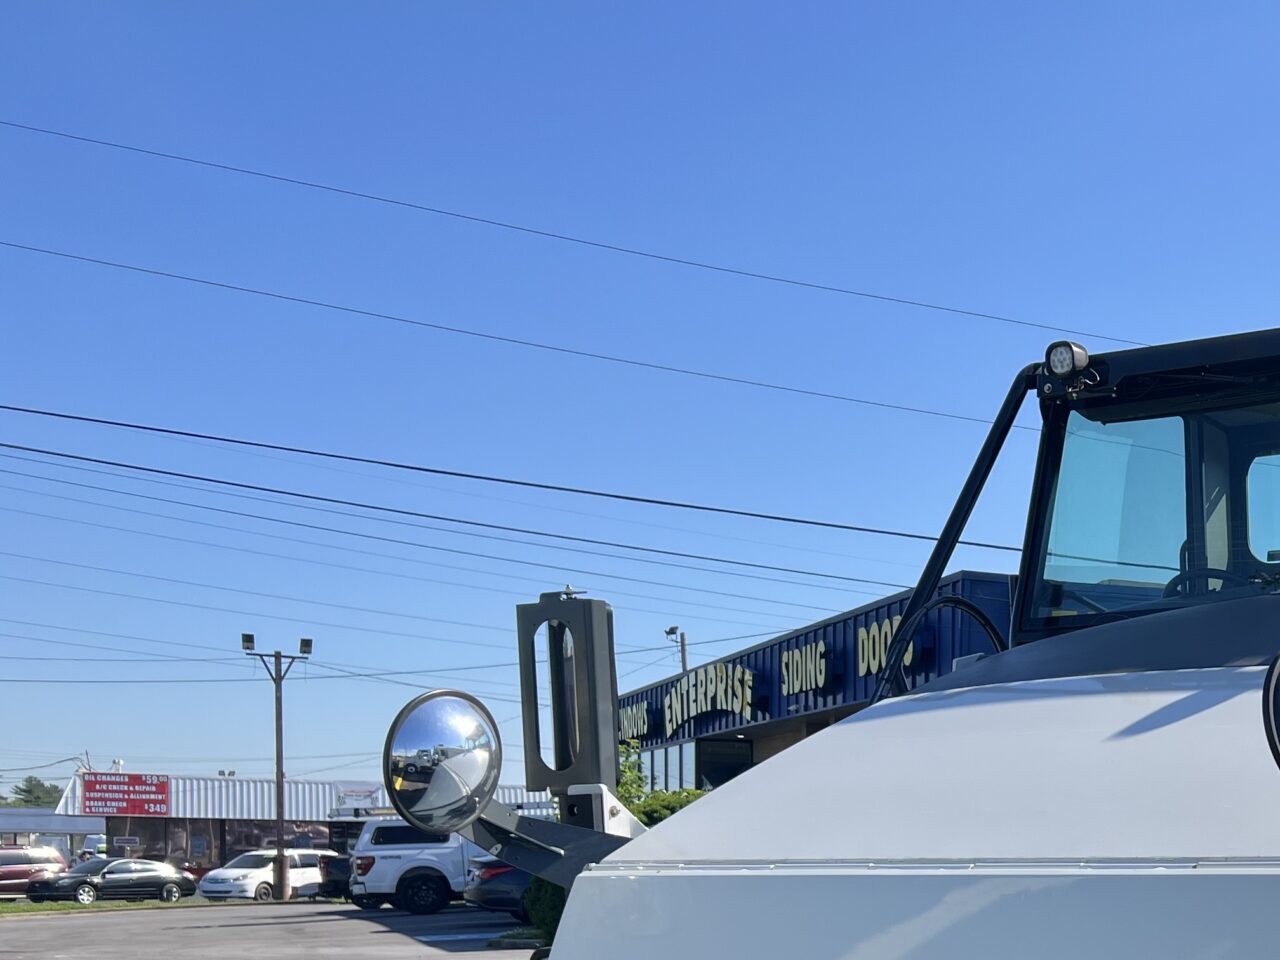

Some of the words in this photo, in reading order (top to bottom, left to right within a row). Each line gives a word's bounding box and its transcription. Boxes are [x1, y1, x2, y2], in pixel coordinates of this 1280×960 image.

[619, 700, 648, 740] INDOWS
[664, 663, 753, 738] ENTERPRISE
[782, 640, 826, 696] SIDING
[858, 615, 913, 677] DOO
[97, 774, 129, 782] CHANGES
